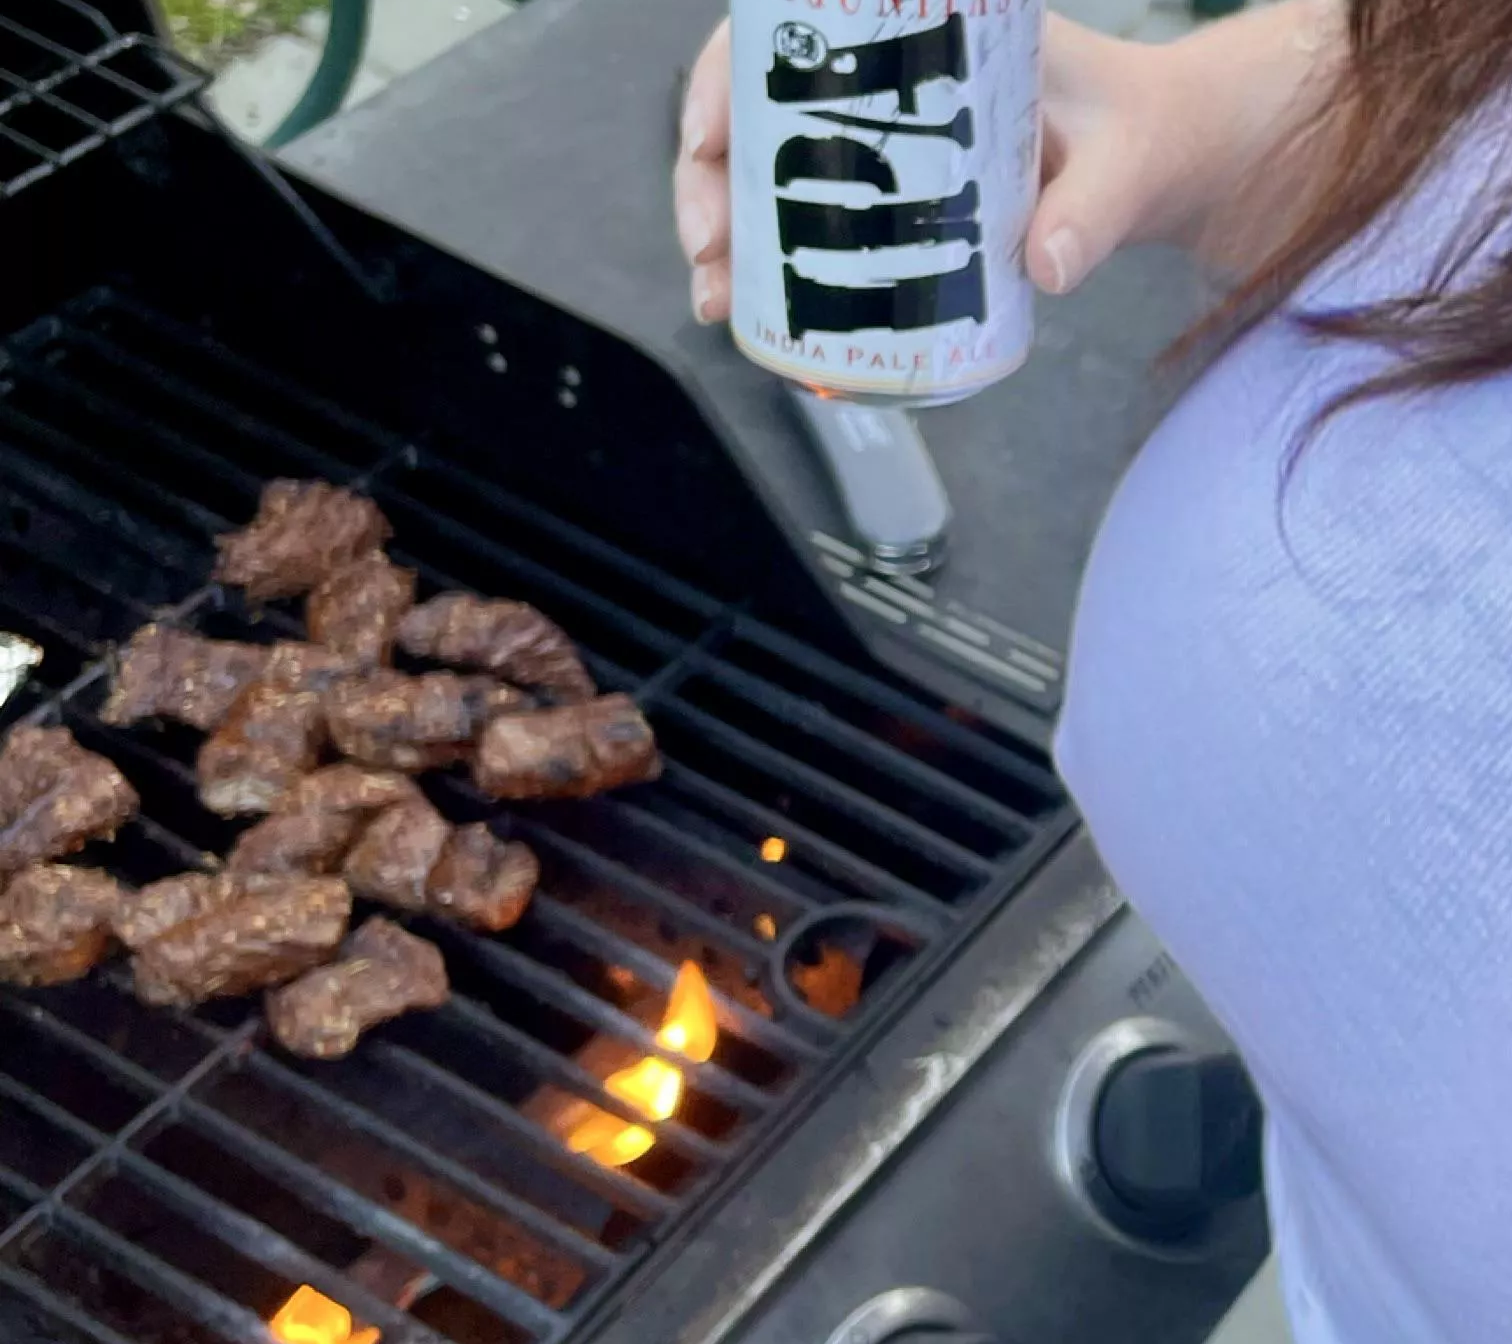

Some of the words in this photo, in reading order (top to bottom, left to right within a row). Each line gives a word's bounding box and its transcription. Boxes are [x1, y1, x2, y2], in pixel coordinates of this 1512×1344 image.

[766, 12, 986, 340] IPA
[755, 319, 826, 362] INDIA
[846, 345, 928, 371] PALE
[948, 340, 997, 366] ALE
